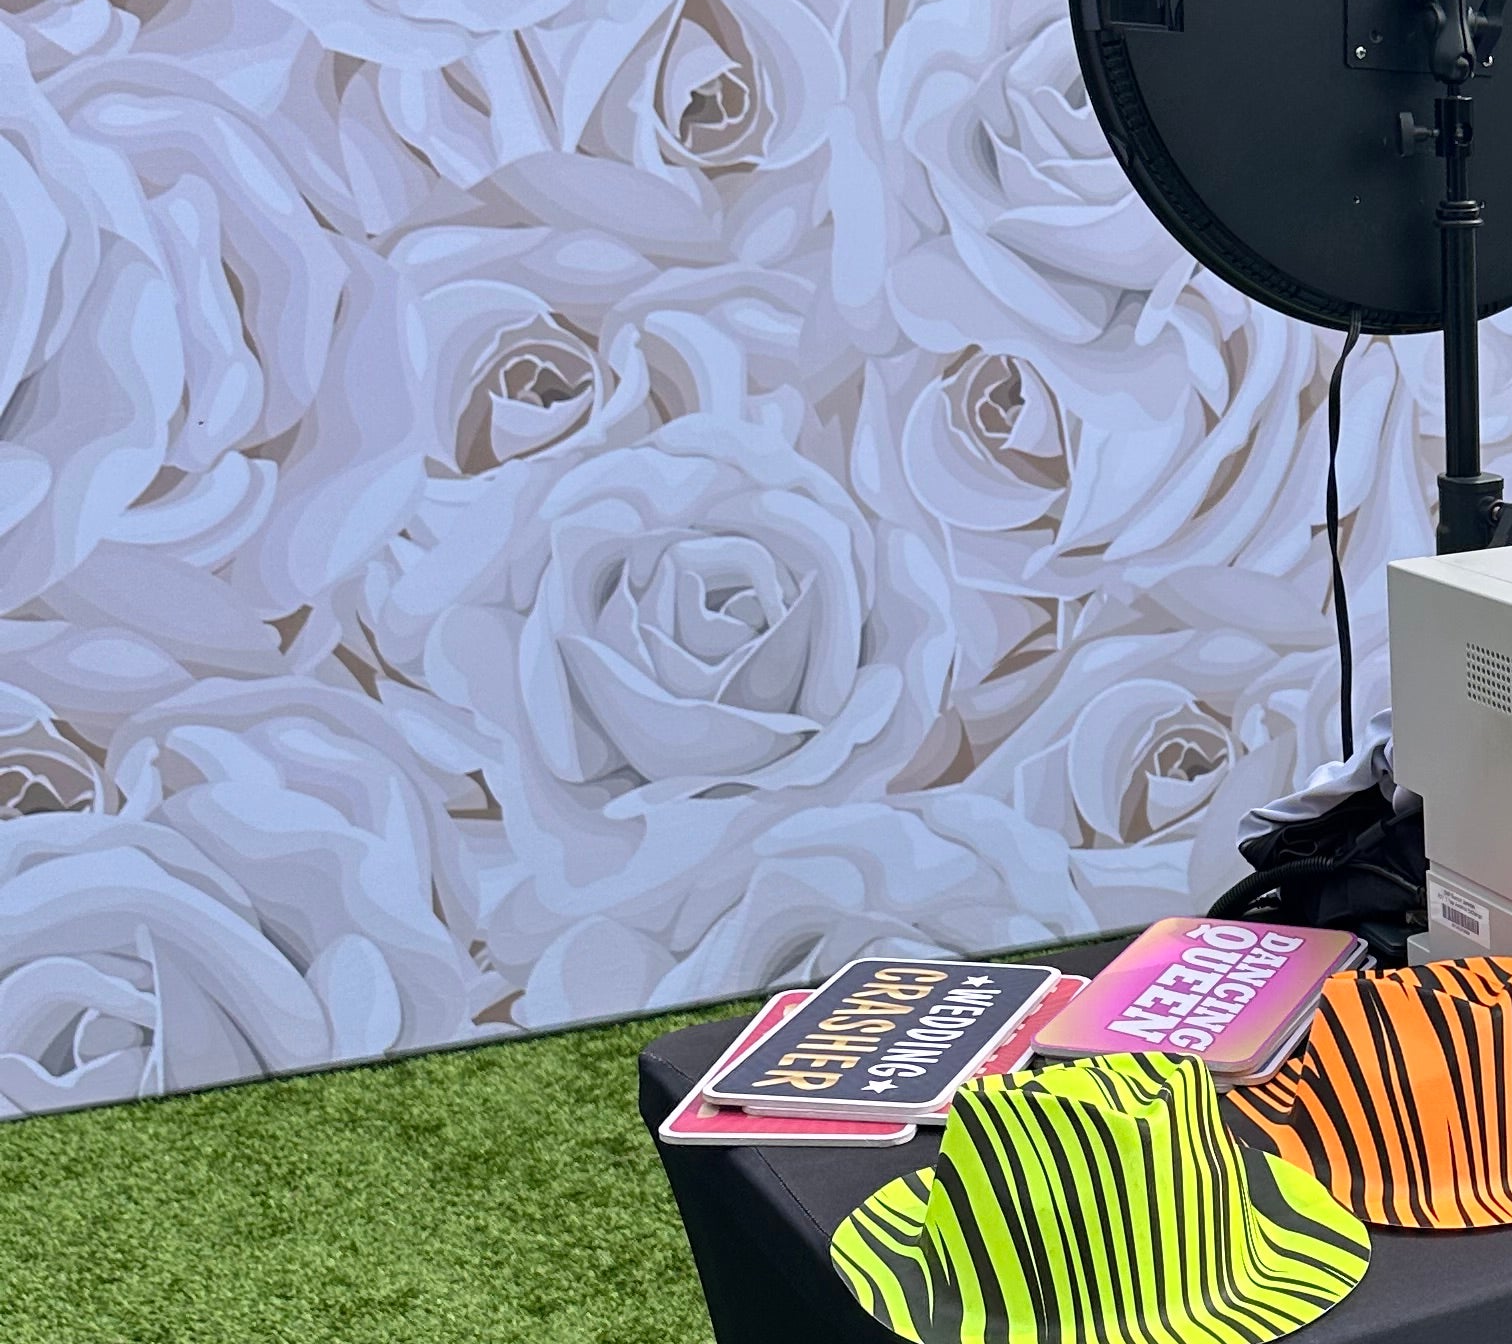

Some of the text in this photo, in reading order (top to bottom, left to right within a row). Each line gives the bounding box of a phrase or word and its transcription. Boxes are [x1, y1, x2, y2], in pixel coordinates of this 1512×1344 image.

[752, 967, 949, 1091] CRASHER
[867, 988, 1002, 1079] WEDDING
[1108, 924, 1258, 1044] QUEEN
[1168, 931, 1304, 1052] DANCING
